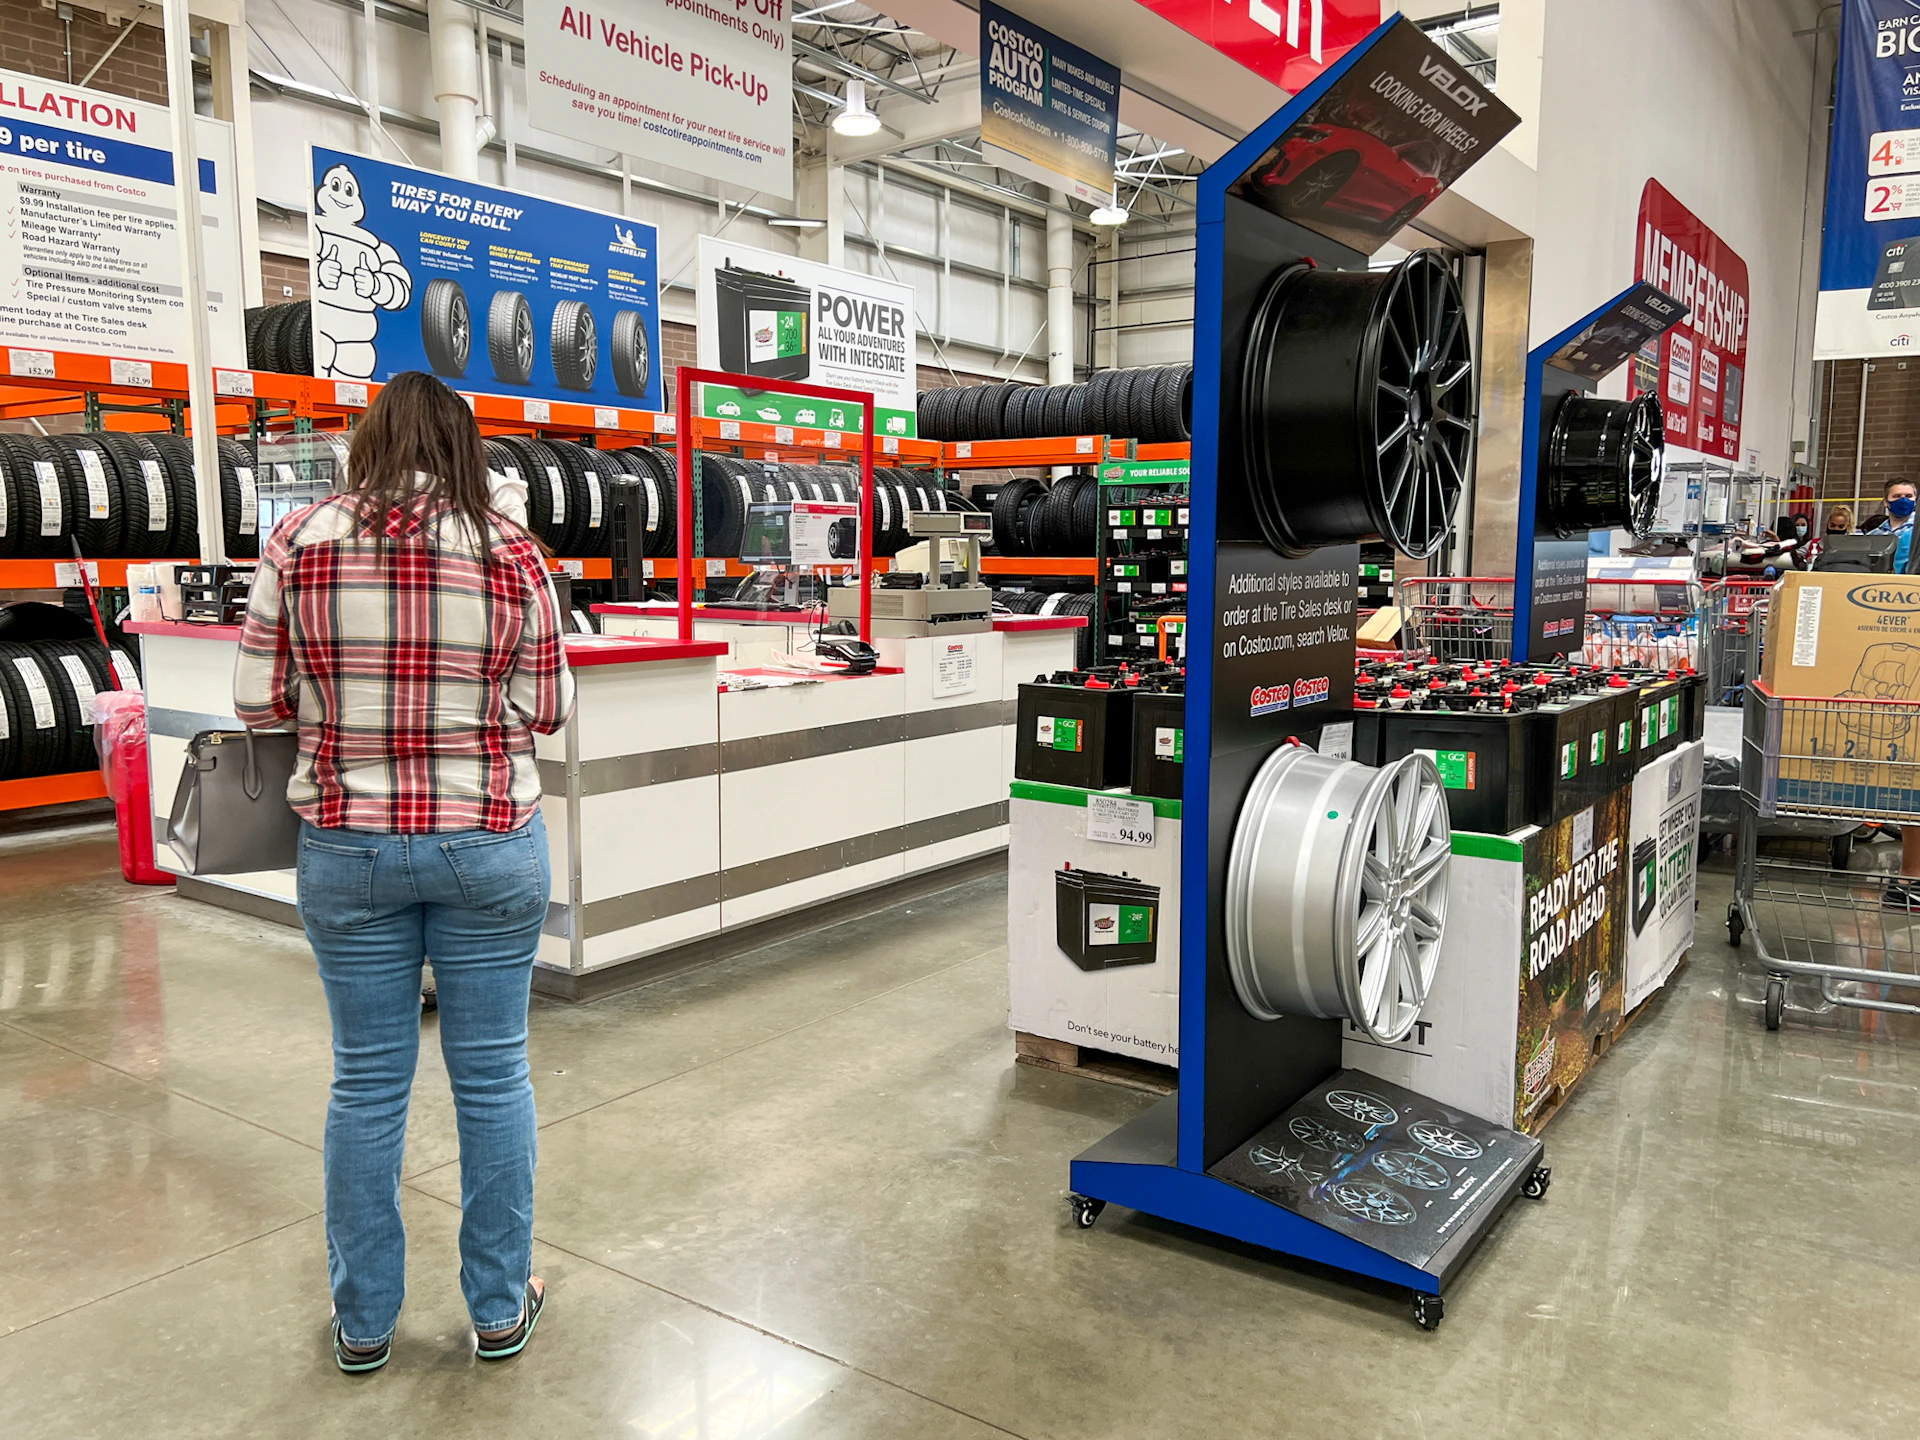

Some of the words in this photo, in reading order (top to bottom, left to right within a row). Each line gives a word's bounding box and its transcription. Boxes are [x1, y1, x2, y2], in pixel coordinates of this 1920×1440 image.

[1878, 16, 1908, 30] EARN
[752, 22, 784, 51] Only)
[988, 19, 1043, 63] COSTCO
[559, 6, 592, 40] All
[600, 19, 683, 72] Vehicle
[690, 52, 769, 105] Pick-Up
[988, 42, 1043, 89] AUTO
[988, 68, 1043, 107] PROGRAM
[1051, 55, 1067, 71] MANY
[1067, 62, 1085, 81] MAKES
[1084, 70, 1095, 85] AND
[1095, 75, 1115, 96] MODELS
[1418, 55, 1488, 117] VELOX
[1051, 77, 1084, 102] LIMITED-TIME
[1084, 91, 1106, 112] SPECIALS
[539, 71, 595, 100] Scheduling
[598, 90, 610, 101] an
[612, 94, 670, 121] appointment
[672, 112, 684, 126] for
[686, 119, 706, 133] your
[708, 125, 726, 139] next
[728, 131, 741, 142] tire
[742, 136, 771, 153] service
[772, 146, 786, 157] will
[993, 101, 1051, 137] CostcoAuto.com
[1051, 98, 1067, 115] PARTS
[1072, 107, 1091, 125] SERVICE
[1091, 115, 1110, 134] COUPON
[1369, 71, 1423, 114] LOOKING
[1413, 103, 1443, 129] FOR
[1433, 117, 1479, 154] WHEELS?
[572, 99, 594, 113] save
[597, 105, 615, 121] you
[617, 111, 641, 127] time!
[643, 120, 762, 163] costcotireappointments.com
[19, 132, 59, 155] per
[65, 140, 107, 164] tire
[7, 166, 20, 174] on
[21, 167, 42, 179] tires
[44, 172, 92, 188] purchased
[93, 179, 114, 192] from
[116, 185, 147, 198] Costco
[20, 184, 61, 200] Warranty
[19, 196, 45, 208] $9.99
[46, 200, 96, 217] Installation
[97, 209, 111, 219] fee
[112, 212, 127, 224] per
[128, 214, 143, 225] tire
[144, 218, 177, 231] applies.
[390, 180, 438, 203] TIRES
[439, 192, 472, 210] FOR
[474, 200, 523, 221] EVERY
[390, 195, 432, 216] WAY
[434, 205, 467, 222] YOU
[469, 213, 511, 232] ROLL.
[20, 208, 88, 227] Manufacturer's
[90, 219, 122, 233] Limited
[124, 224, 162, 240] Warranty
[21, 220, 57, 235] Mileage
[22, 231, 46, 244] Road
[48, 235, 80, 249] Hazard
[81, 240, 121, 256] Warranty
[419, 231, 456, 243] LONGEVITY
[456, 238, 470, 246] YOU
[419, 237, 434, 246] CAN
[434, 239, 456, 249] COUNT
[489, 245, 508, 253] PEACE
[608, 244, 647, 259] MICHELIN
[1886, 243, 1905, 257] citi
[489, 251, 508, 259] WHEN
[514, 255, 541, 265] MATTERS
[549, 256, 590, 269] PERFORMANCE
[24, 267, 63, 282] Optional
[65, 272, 90, 284] Items
[97, 277, 140, 291] additional
[141, 284, 160, 293] cost
[26, 279, 43, 290] Tire
[46, 281, 86, 295] Pressure
[88, 287, 134, 303] Monitoring
[136, 294, 167, 307] System
[1642, 221, 1745, 356] MEMBERSHIP
[26, 291, 60, 304] Special
[67, 297, 100, 309] custom
[102, 302, 125, 312] valve
[127, 304, 153, 316] stems
[817, 291, 905, 339] POWER
[1644, 295, 1675, 316] VELOX
[18, 318, 62, 331] purchase
[63, 322, 73, 330] at
[74, 323, 128, 336] Costco.com
[25, 307, 52, 320] today
[54, 311, 63, 319] at
[65, 311, 80, 321] the
[81, 313, 98, 325] Tire
[100, 316, 125, 327] Sales
[127, 319, 148, 329] desk
[784, 315, 794, 328] 24
[785, 328, 798, 340] 700
[817, 325, 833, 340] ALL
[833, 328, 856, 345] YOUR
[857, 333, 905, 354] ADVENTURES
[1890, 334, 1910, 347] citi
[817, 342, 847, 364] WITH
[850, 346, 905, 373] INTERSTATE
[1671, 339, 1691, 364] COSTCO
[28, 367, 54, 376] 152.99
[1701, 355, 1717, 377] COSTCO
[127, 376, 151, 385] 152.99
[231, 386, 253, 394] 152.99
[1130, 469, 1147, 477] YOUR
[1149, 467, 1177, 477] RELIABLE
[1229, 571, 1276, 594] Additional
[1277, 572, 1303, 596] styles
[1304, 570, 1340, 590] available
[1341, 573, 1350, 587] to
[1862, 588, 1920, 605] GRAC
[1223, 605, 1249, 627] order
[1251, 607, 1262, 624] at
[1263, 603, 1278, 622] the
[1280, 601, 1296, 621] Tire
[1298, 599, 1321, 619] Sales
[1323, 597, 1342, 616] desk
[1343, 599, 1352, 614] or
[1877, 615, 1907, 626] 4EVER
[1223, 641, 1236, 659] on
[1238, 634, 1295, 656] Costco.com,
[1297, 629, 1325, 648] search
[1326, 624, 1350, 643] Velox.
[1251, 684, 1290, 707] COSTCO
[1294, 677, 1329, 699] COSTCO
[1062, 720, 1075, 728] GC2
[1447, 753, 1465, 762] GC2
[1685, 799, 1697, 820] YOU
[1119, 828, 1153, 844] 94.99
[1659, 838, 1693, 900] BATTERY
[1530, 869, 1573, 936] READY
[1573, 856, 1597, 901] FOR
[1597, 837, 1619, 880] THE
[1529, 918, 1567, 981] ROAD
[1568, 884, 1606, 947] AHEAD
[1067, 1020, 1092, 1036] Don't
[1093, 1028, 1109, 1039] see
[1110, 1032, 1131, 1047] your
[1133, 1034, 1167, 1054] battery
[1449, 1175, 1477, 1200] VELOX
